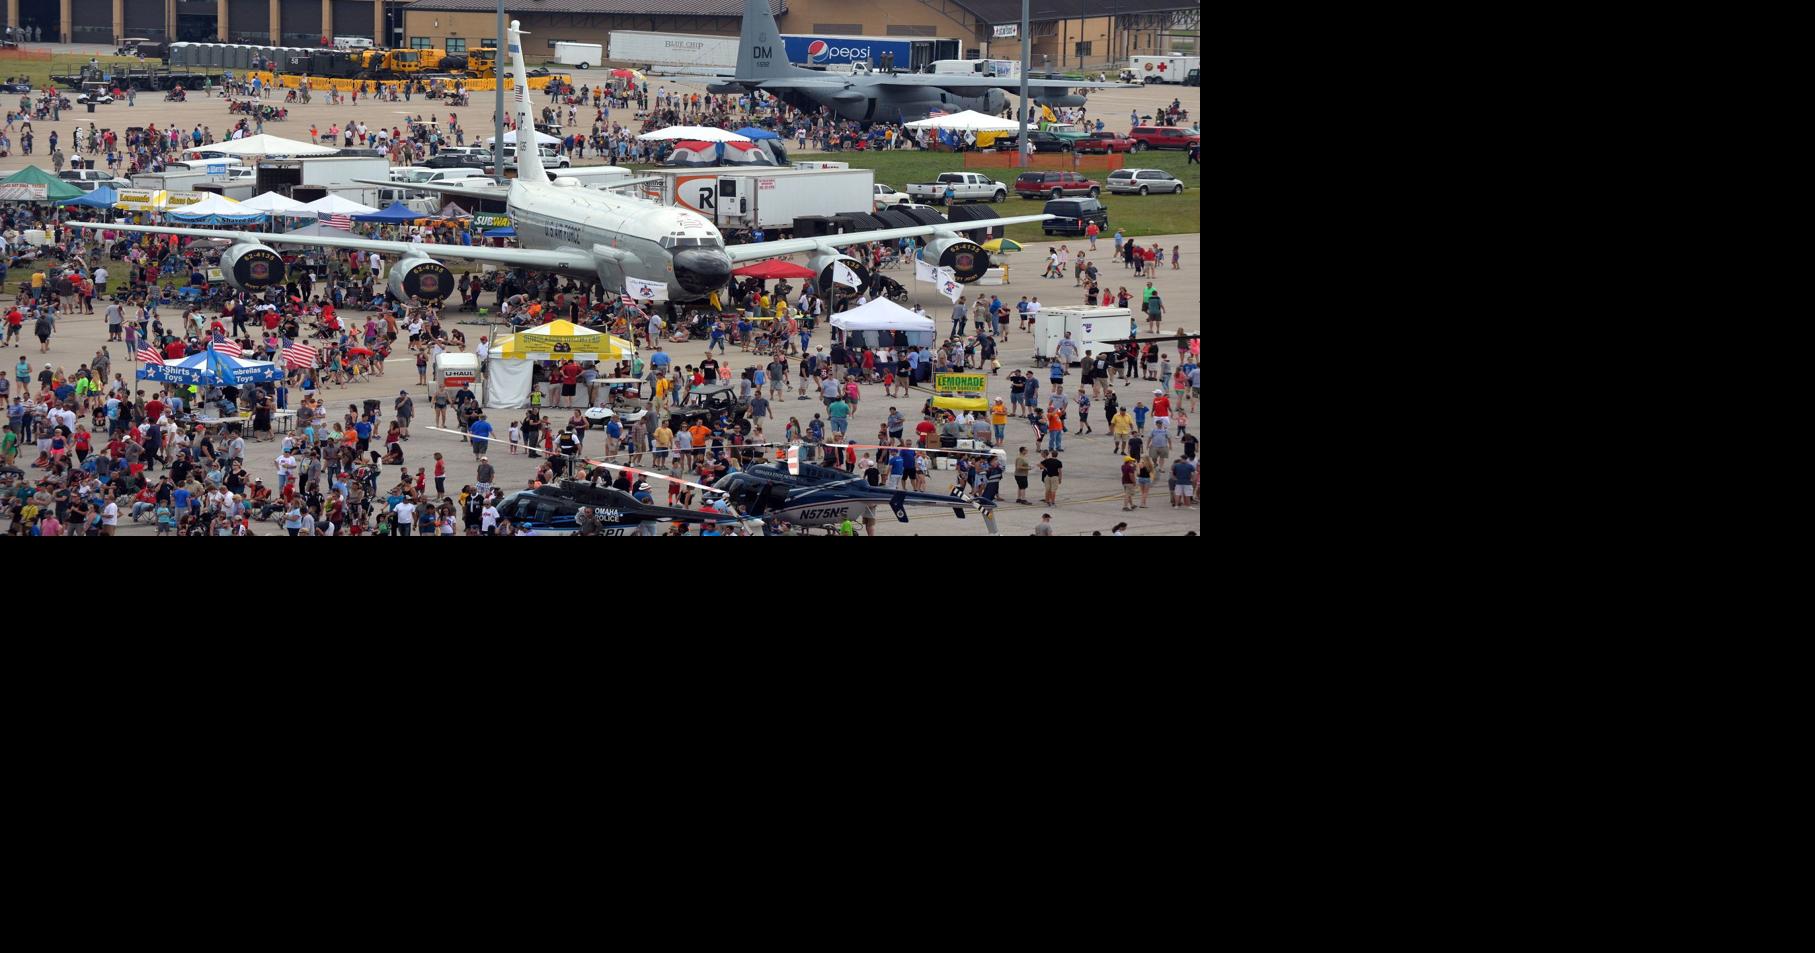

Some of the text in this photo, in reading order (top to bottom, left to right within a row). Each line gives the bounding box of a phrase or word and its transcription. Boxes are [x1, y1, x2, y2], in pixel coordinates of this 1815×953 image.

[753, 46, 772, 59] DM
[829, 46, 870, 60] pepsi
[158, 365, 190, 376] T-Shirts
[233, 368, 261, 376] mbrellas
[164, 373, 184, 383] Toys
[236, 375, 254, 383] Toys
[937, 376, 984, 387] LEMONADE
[594, 507, 619, 517] OMAHA
